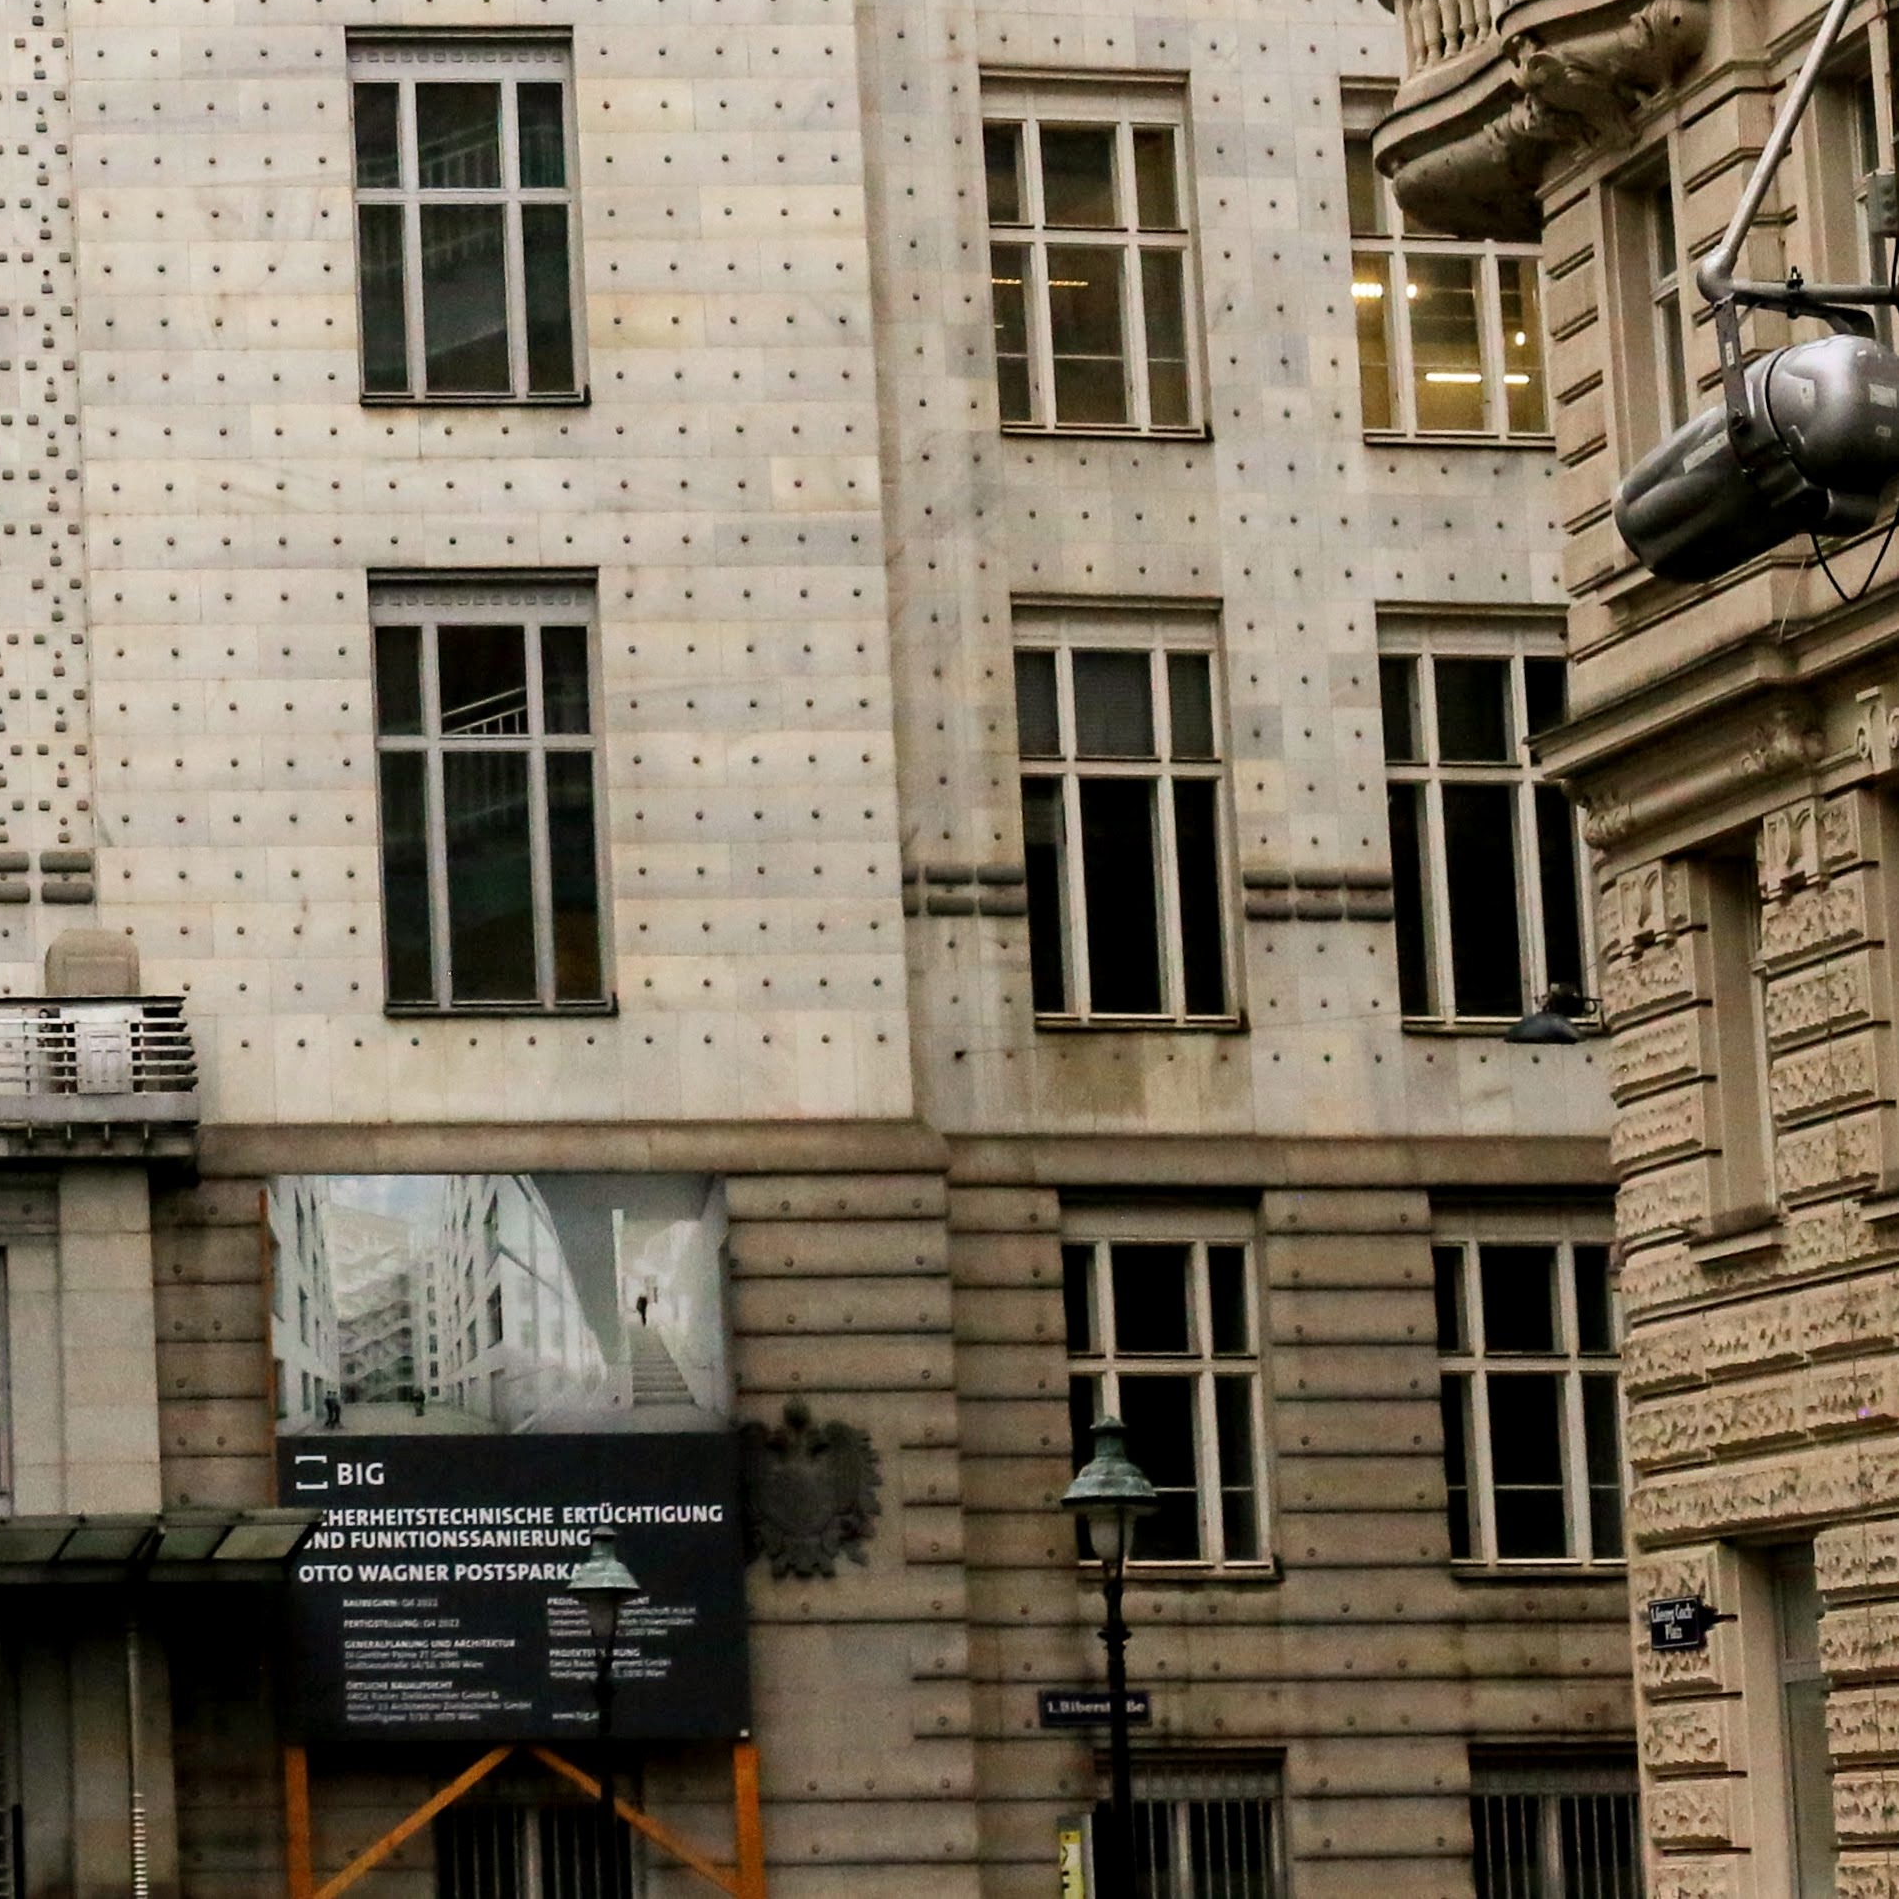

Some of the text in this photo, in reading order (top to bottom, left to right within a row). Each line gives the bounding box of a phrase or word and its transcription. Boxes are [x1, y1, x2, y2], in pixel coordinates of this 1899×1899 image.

[336, 1462, 385, 1486] BIG
[321, 1502, 724, 1527] HERHEITSTECHNISCHE ERTÜCHTIGUNG
[350, 1529, 592, 1549] FUNKTIONSSANIERUNG
[298, 1562, 583, 1583] OTTO WAGNER POSTSPARKA
